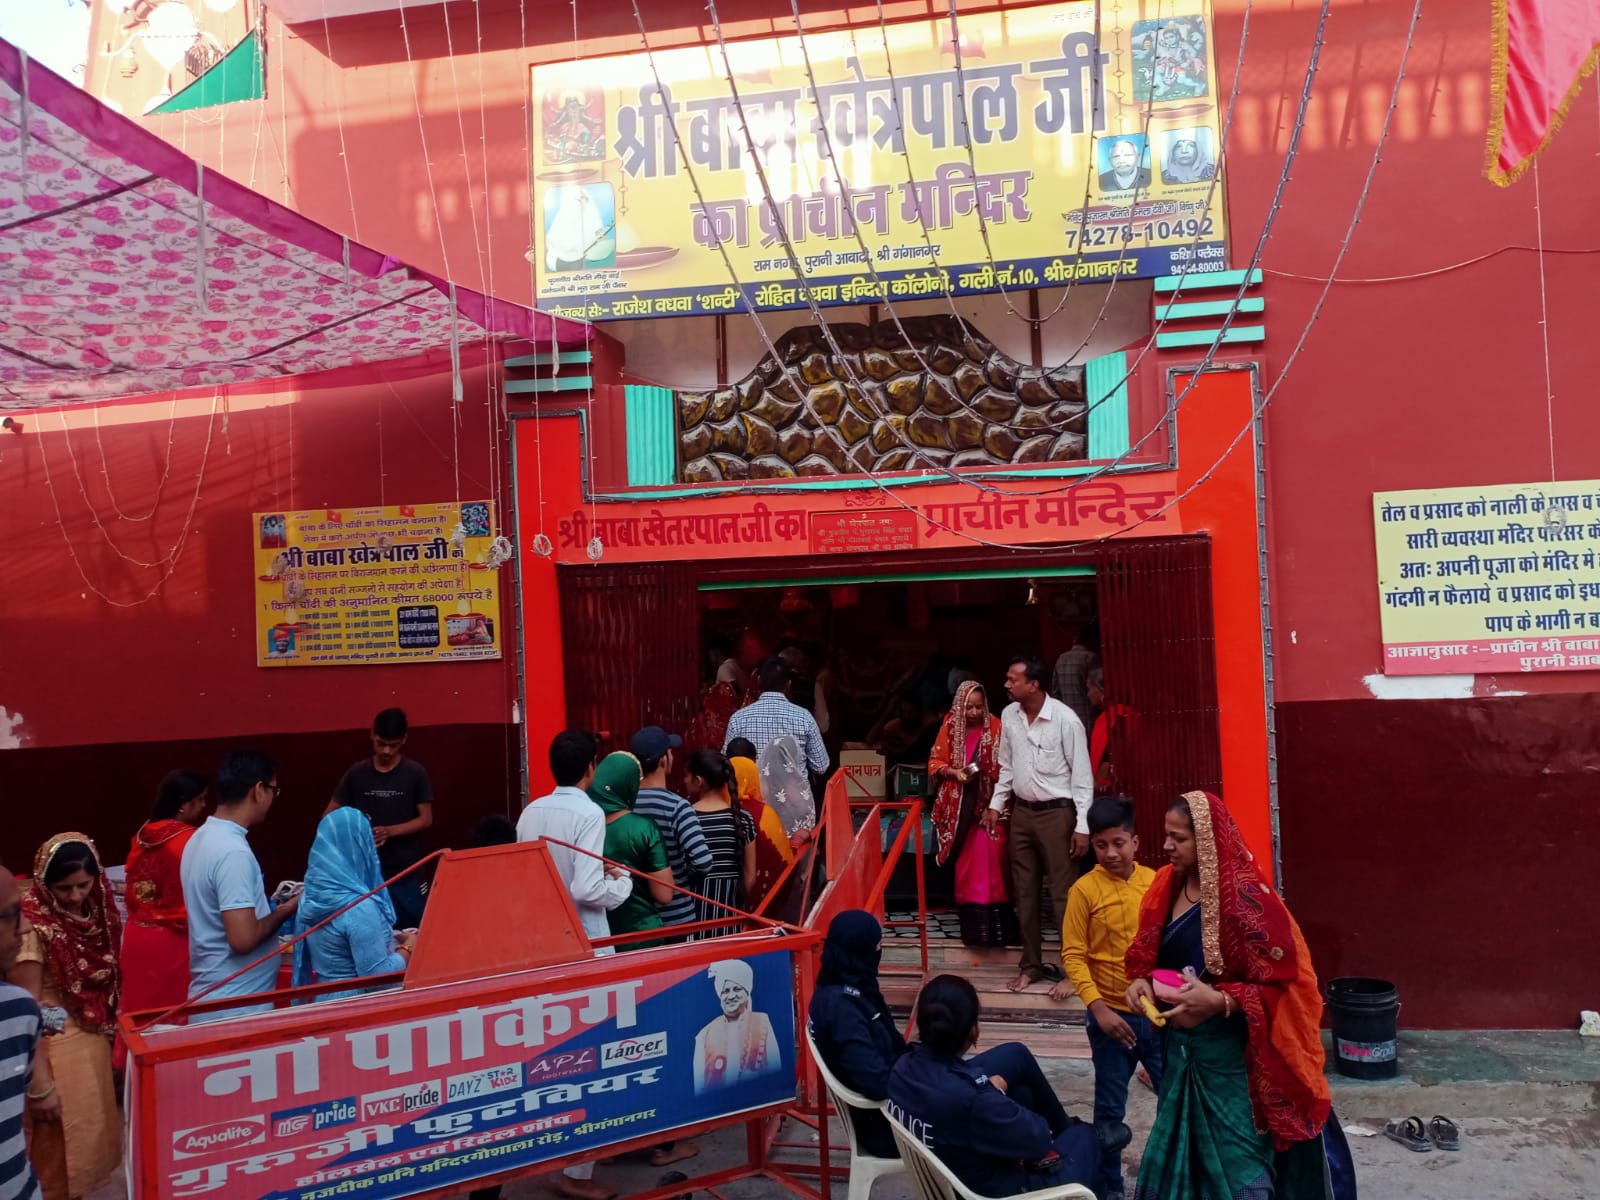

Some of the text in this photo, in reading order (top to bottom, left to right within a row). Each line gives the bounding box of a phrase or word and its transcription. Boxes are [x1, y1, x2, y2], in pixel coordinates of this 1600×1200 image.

[613, 83, 681, 178] श्री
[1030, 31, 1110, 134] जी
[689, 197, 751, 250] का
[1065, 217, 1214, 249] 74278-10492
[612, 295, 652, 316] राजेश
[755, 282, 796, 306] रोहित
[959, 265, 995, 290] गली
[1381, 501, 1406, 522] तेल
[1409, 504, 1420, 520] व
[1423, 501, 1463, 520] प्रसाद
[1466, 496, 1487, 517] को
[1490, 494, 1528, 515] नाली
[1530, 492, 1545, 513] के
[1581, 494, 1593, 510] व
[558, 510, 588, 549] श्री
[589, 518, 641, 548] बाबा
[1406, 528, 1439, 549] सारी
[1441, 529, 1495, 547] व्यवस्था
[305, 549, 346, 566] बाबा
[423, 538, 449, 560] जी
[1436, 555, 1480, 577] अपनी
[1483, 557, 1516, 581] पूजा
[1518, 551, 1539, 573] को
[1541, 549, 1579, 571] मंदिर
[423, 593, 454, 603] 68000
[1385, 586, 1425, 607] गंदगी
[1428, 590, 1440, 606] न
[1497, 586, 1508, 603] व
[1511, 585, 1552, 603] प्रसाद
[1554, 578, 1576, 600] को
[1485, 616, 1513, 632] पाप
[1516, 610, 1531, 631] के
[1536, 609, 1570, 630] भागी
[1573, 613, 1586, 628] न
[1541, 638, 1561, 652] श्री
[1520, 653, 1566, 672] पुरानी
[530, 1050, 594, 1075] APL
[604, 1038, 665, 1061] Lancer
[367, 1084, 439, 1116] VKC pride
[448, 1078, 482, 1098] DAYZ
[315, 1102, 356, 1129] pride
[185, 1126, 254, 1150] Aqualite
